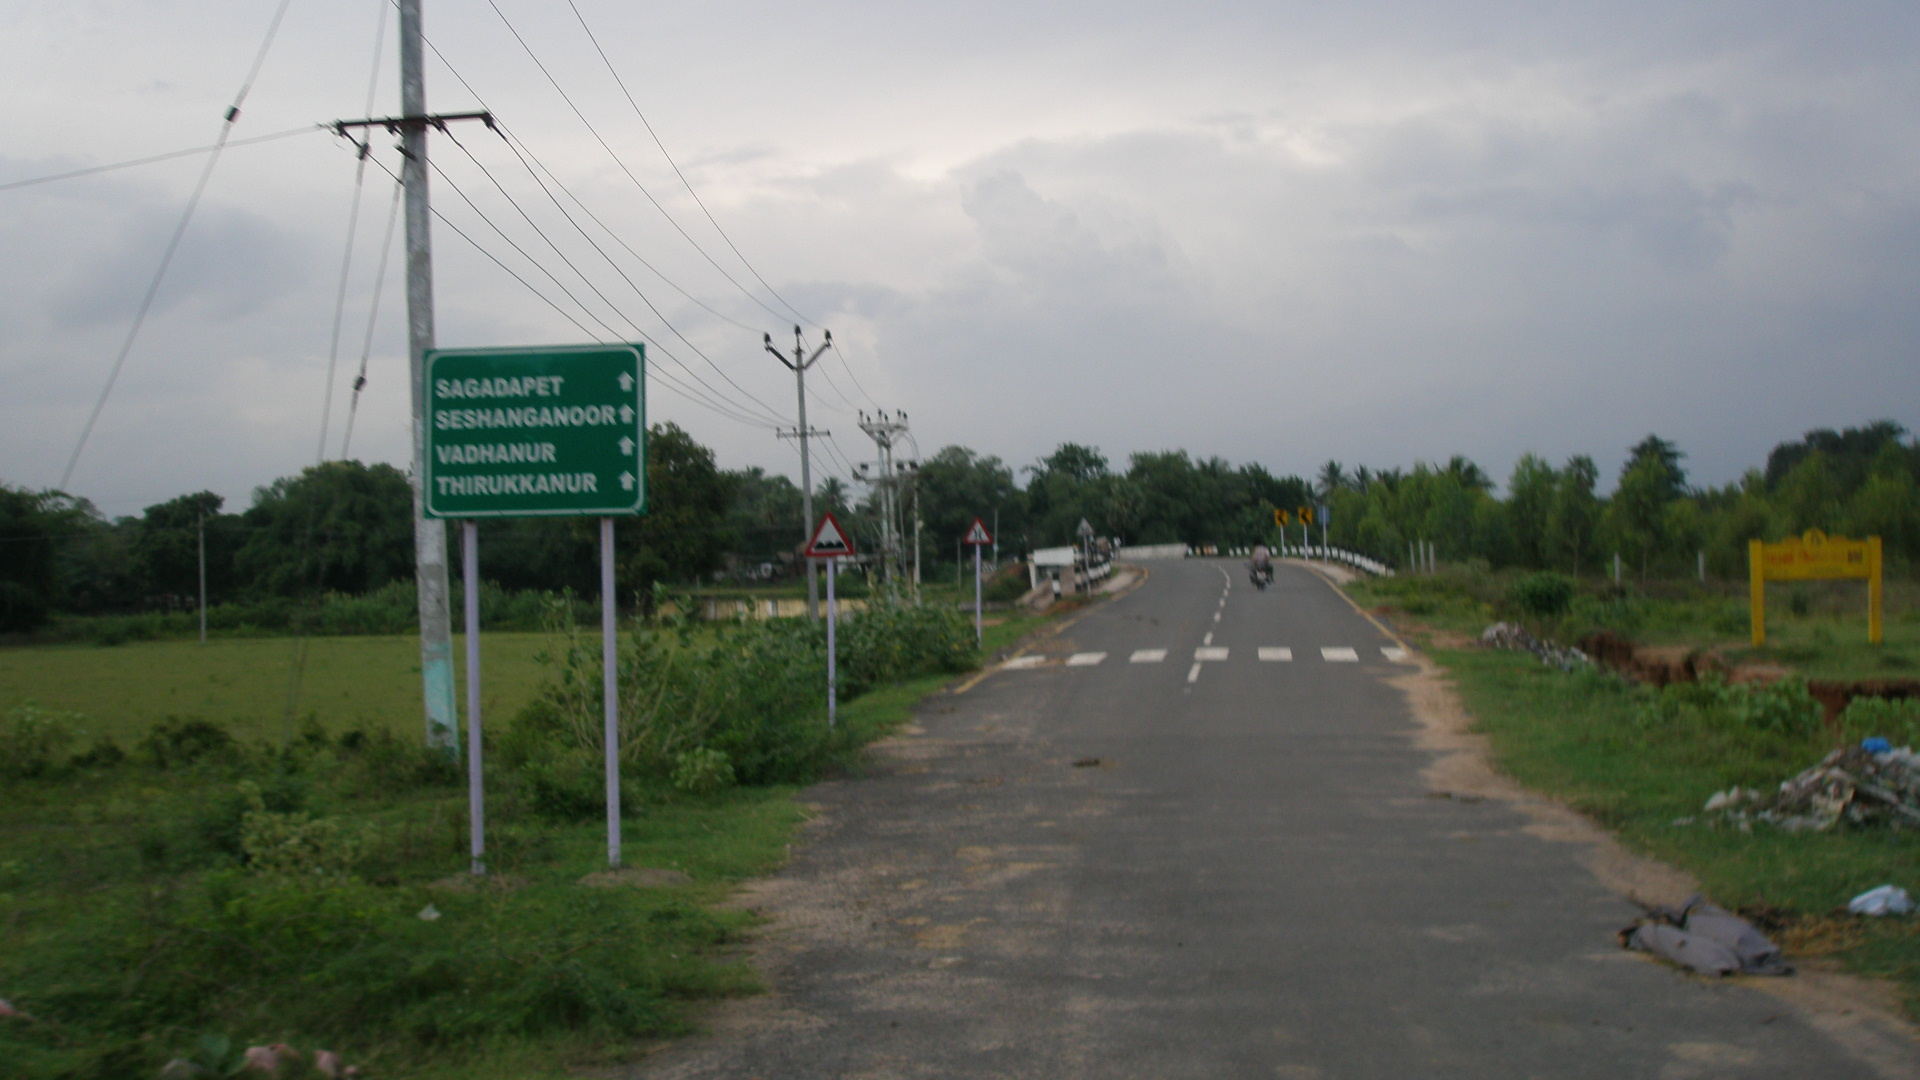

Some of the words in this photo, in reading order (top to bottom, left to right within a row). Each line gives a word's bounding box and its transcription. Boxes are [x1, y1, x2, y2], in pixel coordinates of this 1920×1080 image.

[435, 376, 564, 399] SAGADAPET
[435, 405, 617, 430] SESHANGANOOR
[435, 443, 556, 464] VADHANUR
[435, 473, 597, 495] THIRUKKANUR
